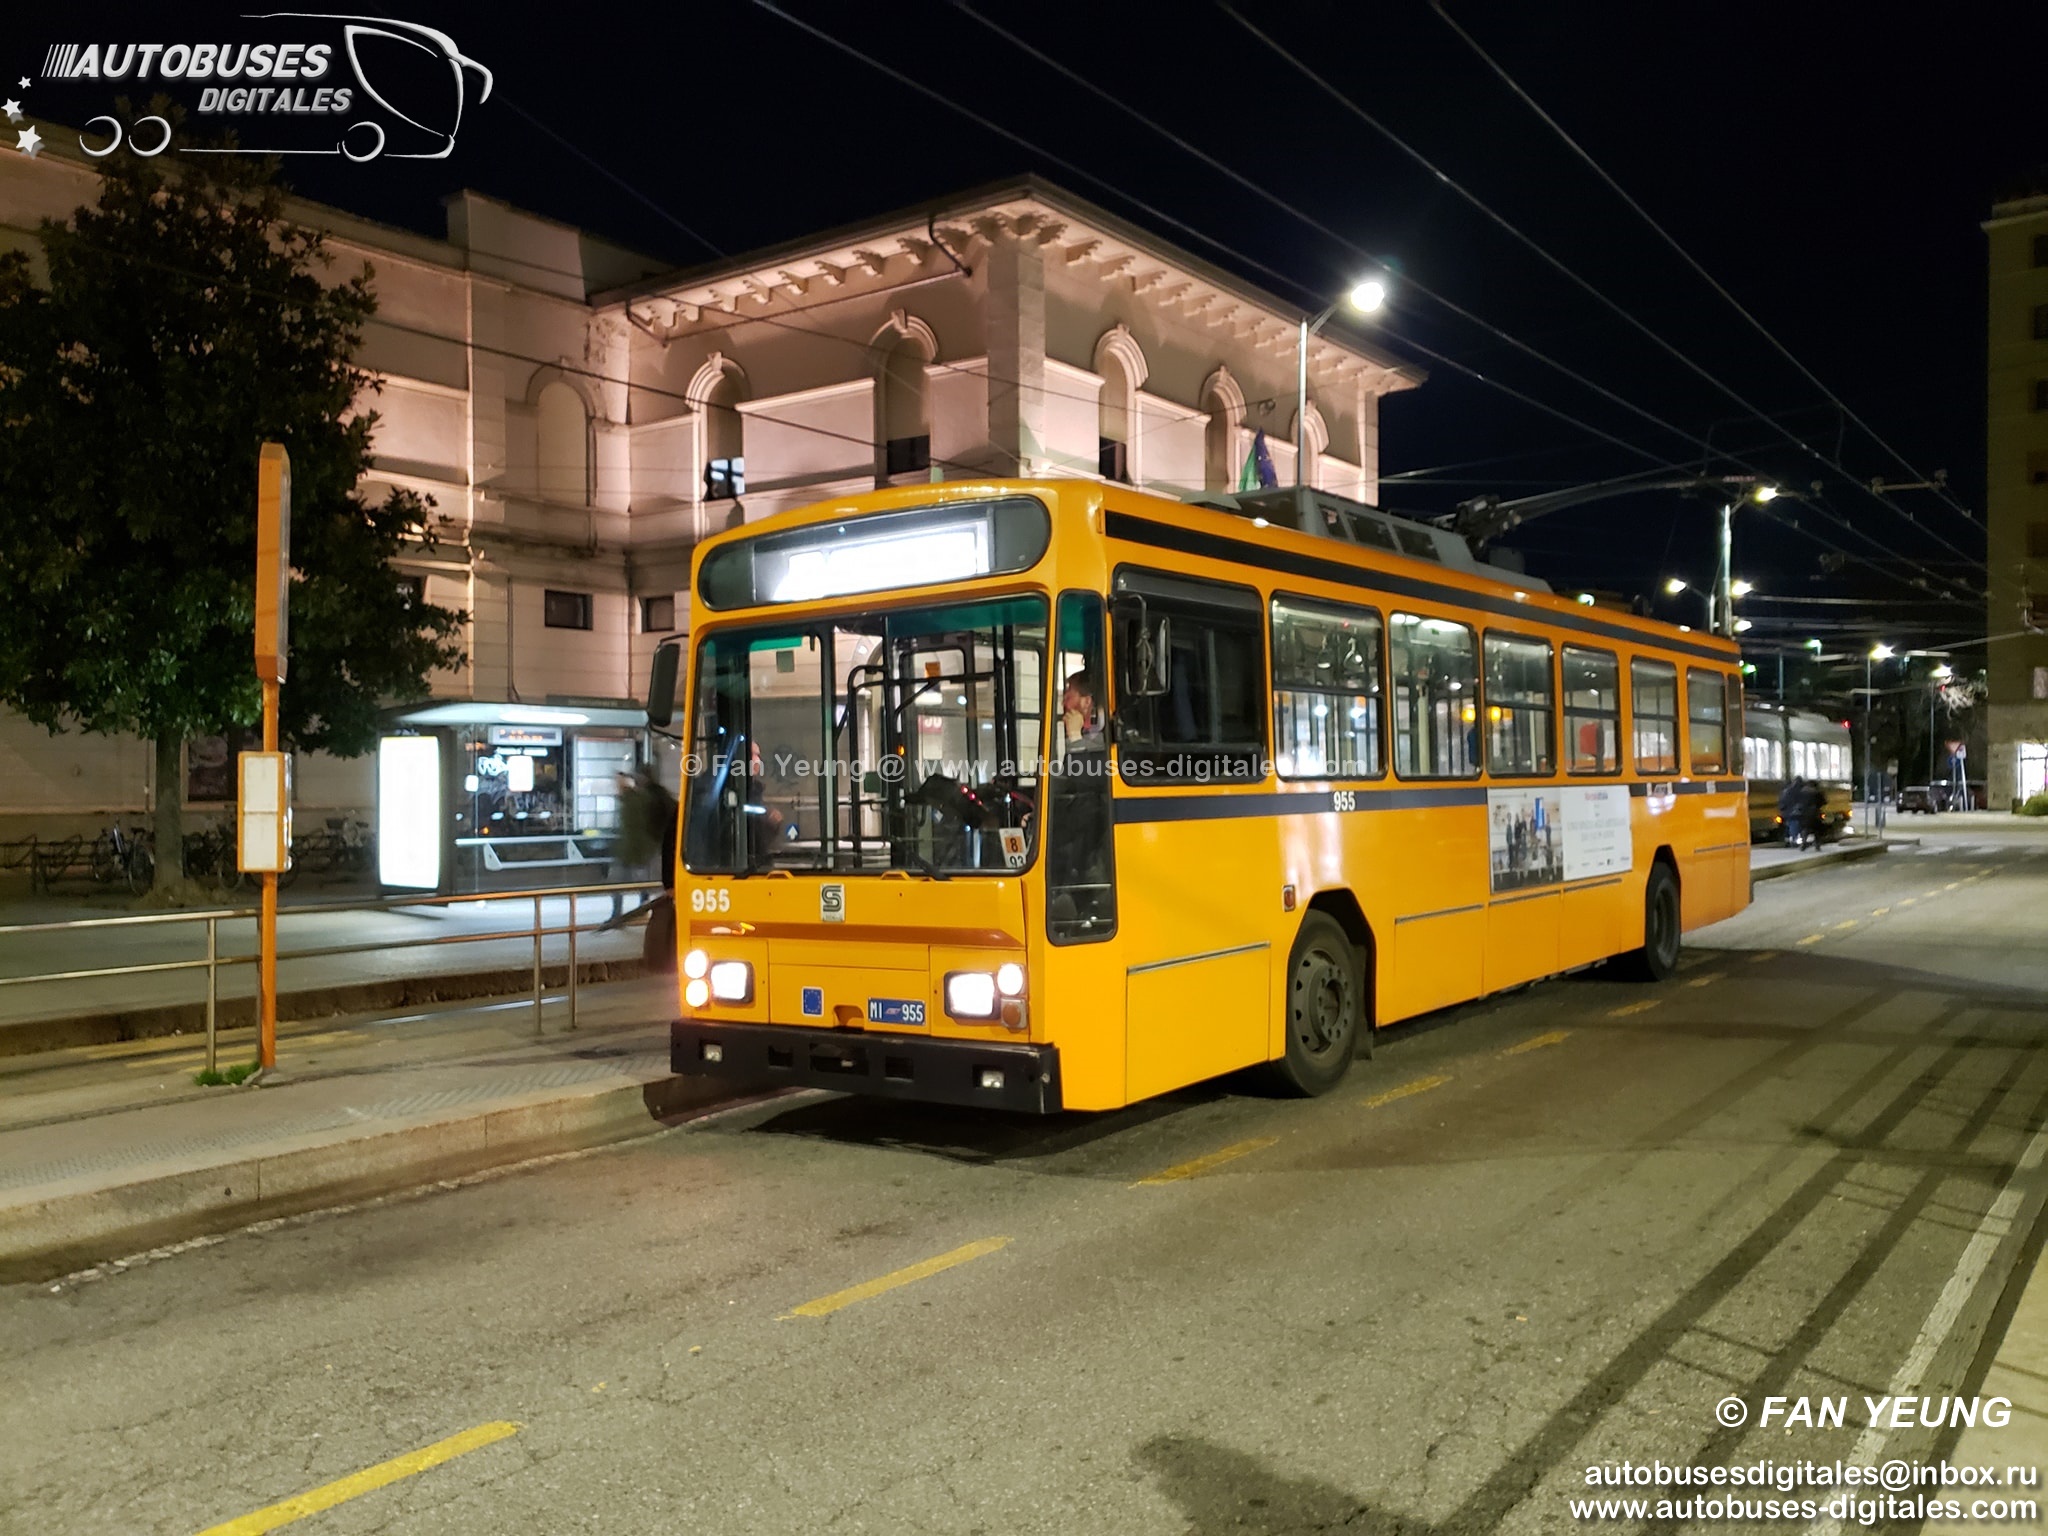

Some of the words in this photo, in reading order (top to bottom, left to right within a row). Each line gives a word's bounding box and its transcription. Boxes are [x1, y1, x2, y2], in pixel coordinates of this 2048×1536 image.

[1333, 791, 1356, 811] 955
[1010, 838, 1018, 852] 8
[691, 888, 731, 913] 955
[870, 1001, 883, 1019] MI
[902, 1003, 924, 1022] 955
